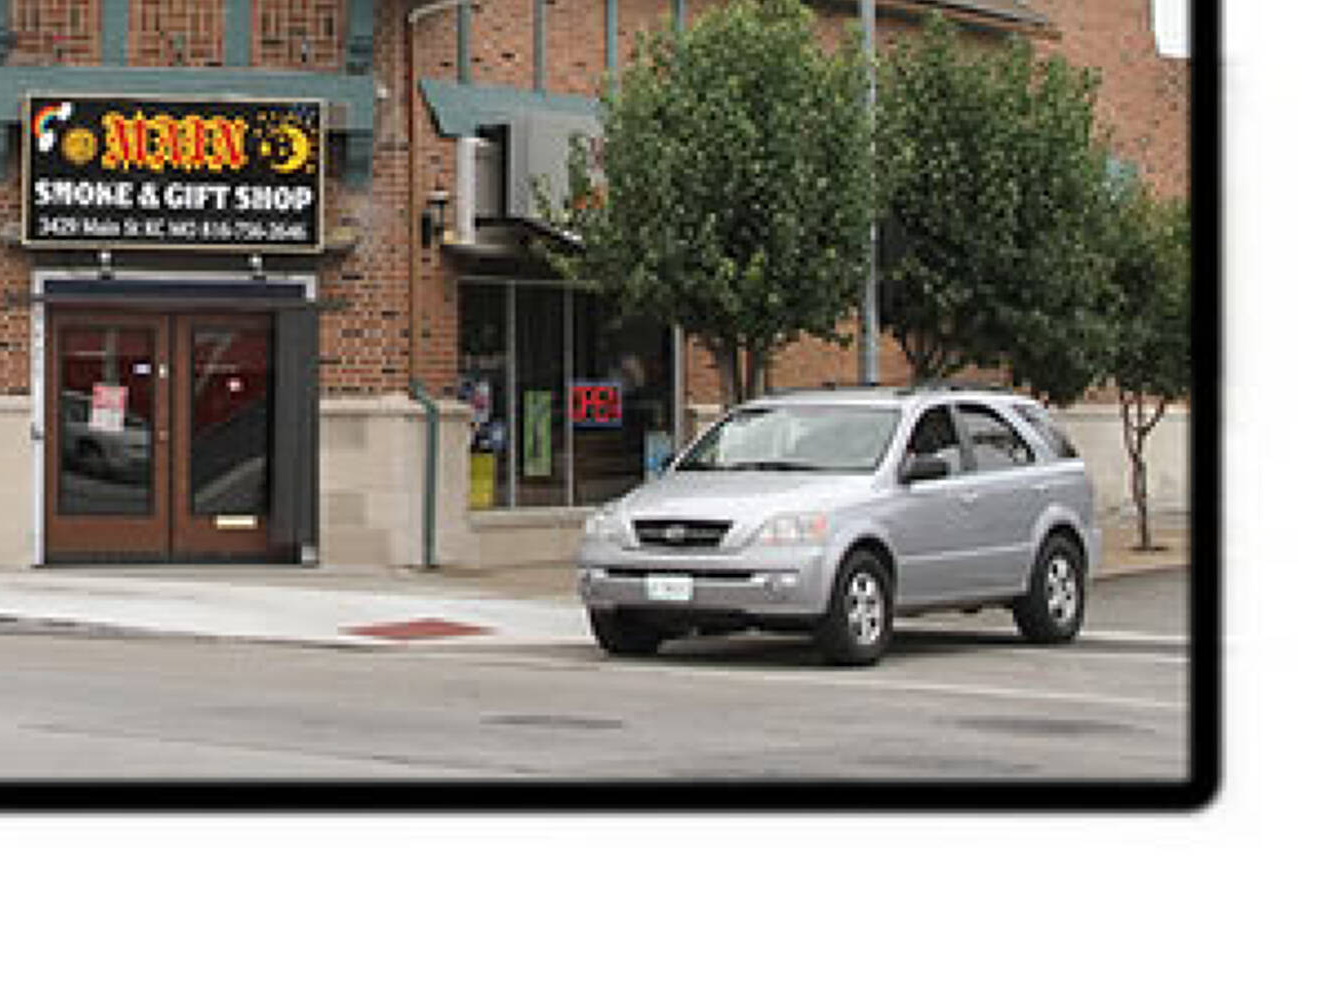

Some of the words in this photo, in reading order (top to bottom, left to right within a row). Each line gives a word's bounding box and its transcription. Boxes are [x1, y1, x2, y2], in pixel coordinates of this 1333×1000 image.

[101, 111, 249, 174] MAIN
[34, 178, 133, 207] SMOKE
[137, 181, 160, 210] &
[164, 182, 231, 211] GIFT
[234, 184, 314, 212] SHOP
